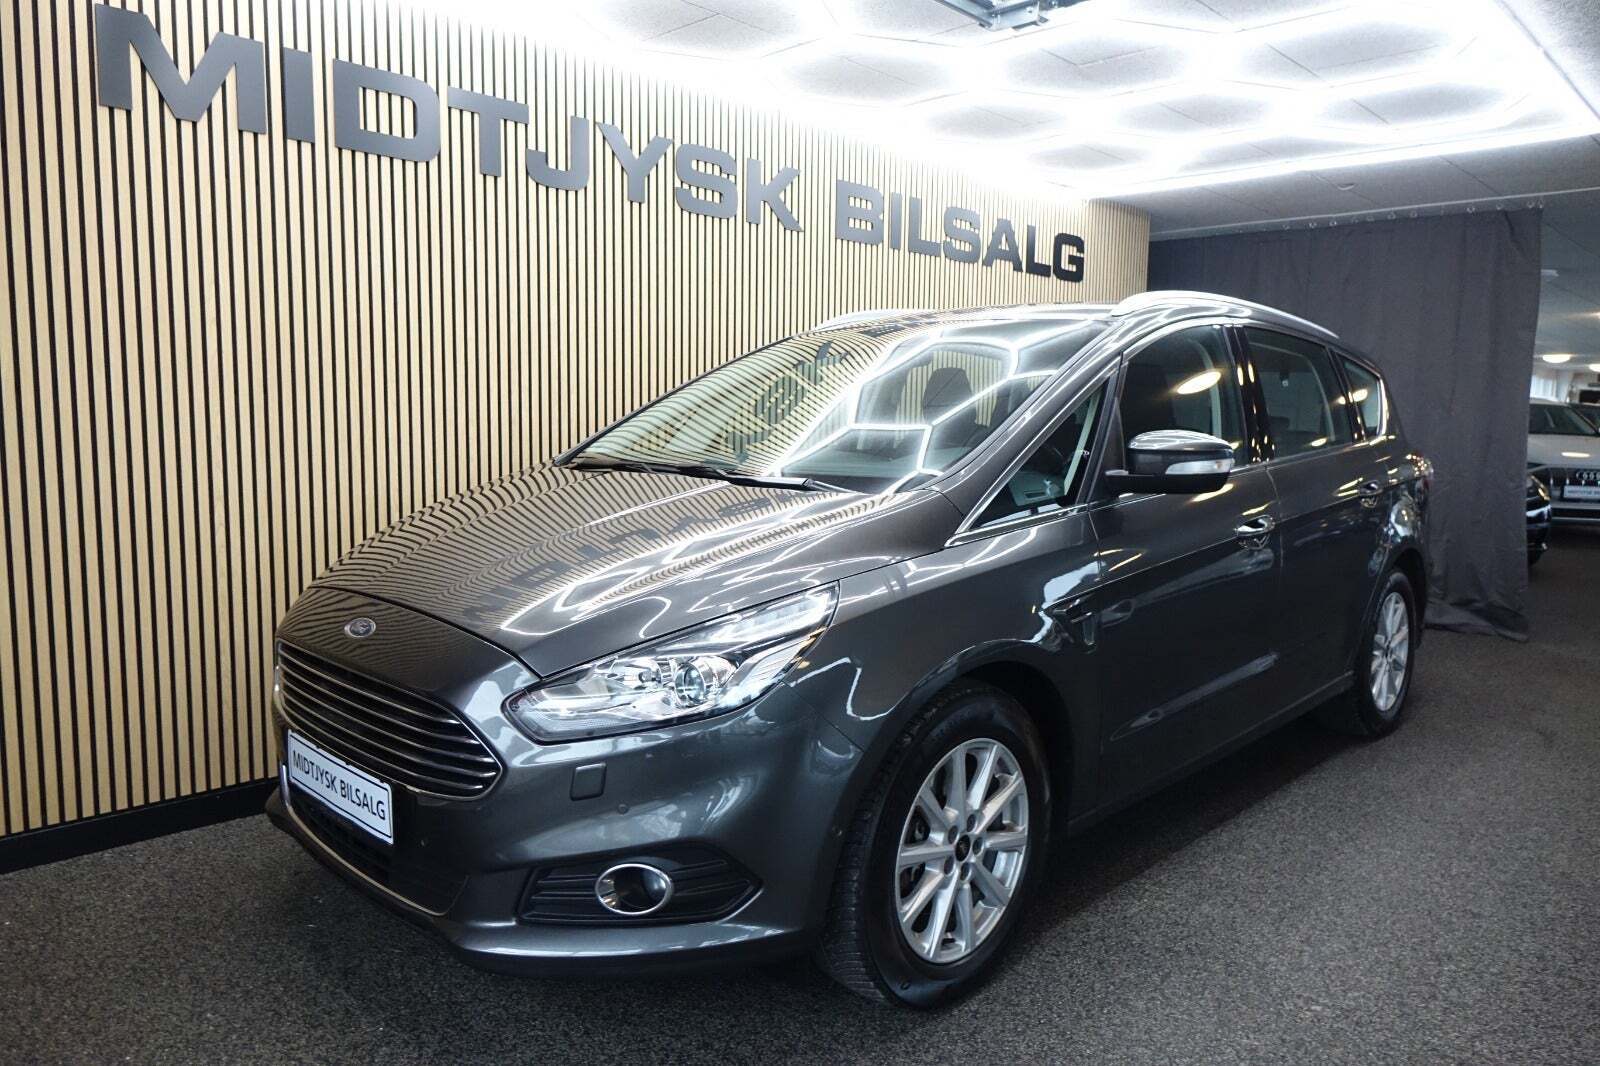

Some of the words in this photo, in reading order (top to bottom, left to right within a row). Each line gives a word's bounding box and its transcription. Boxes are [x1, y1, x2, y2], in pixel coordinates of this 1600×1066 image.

[95, 3, 804, 232] MIDTJYSK
[835, 179, 1085, 283] BILSALG
[293, 750, 338, 793] MIDTJYSK
[340, 779, 386, 820] BILSALG
